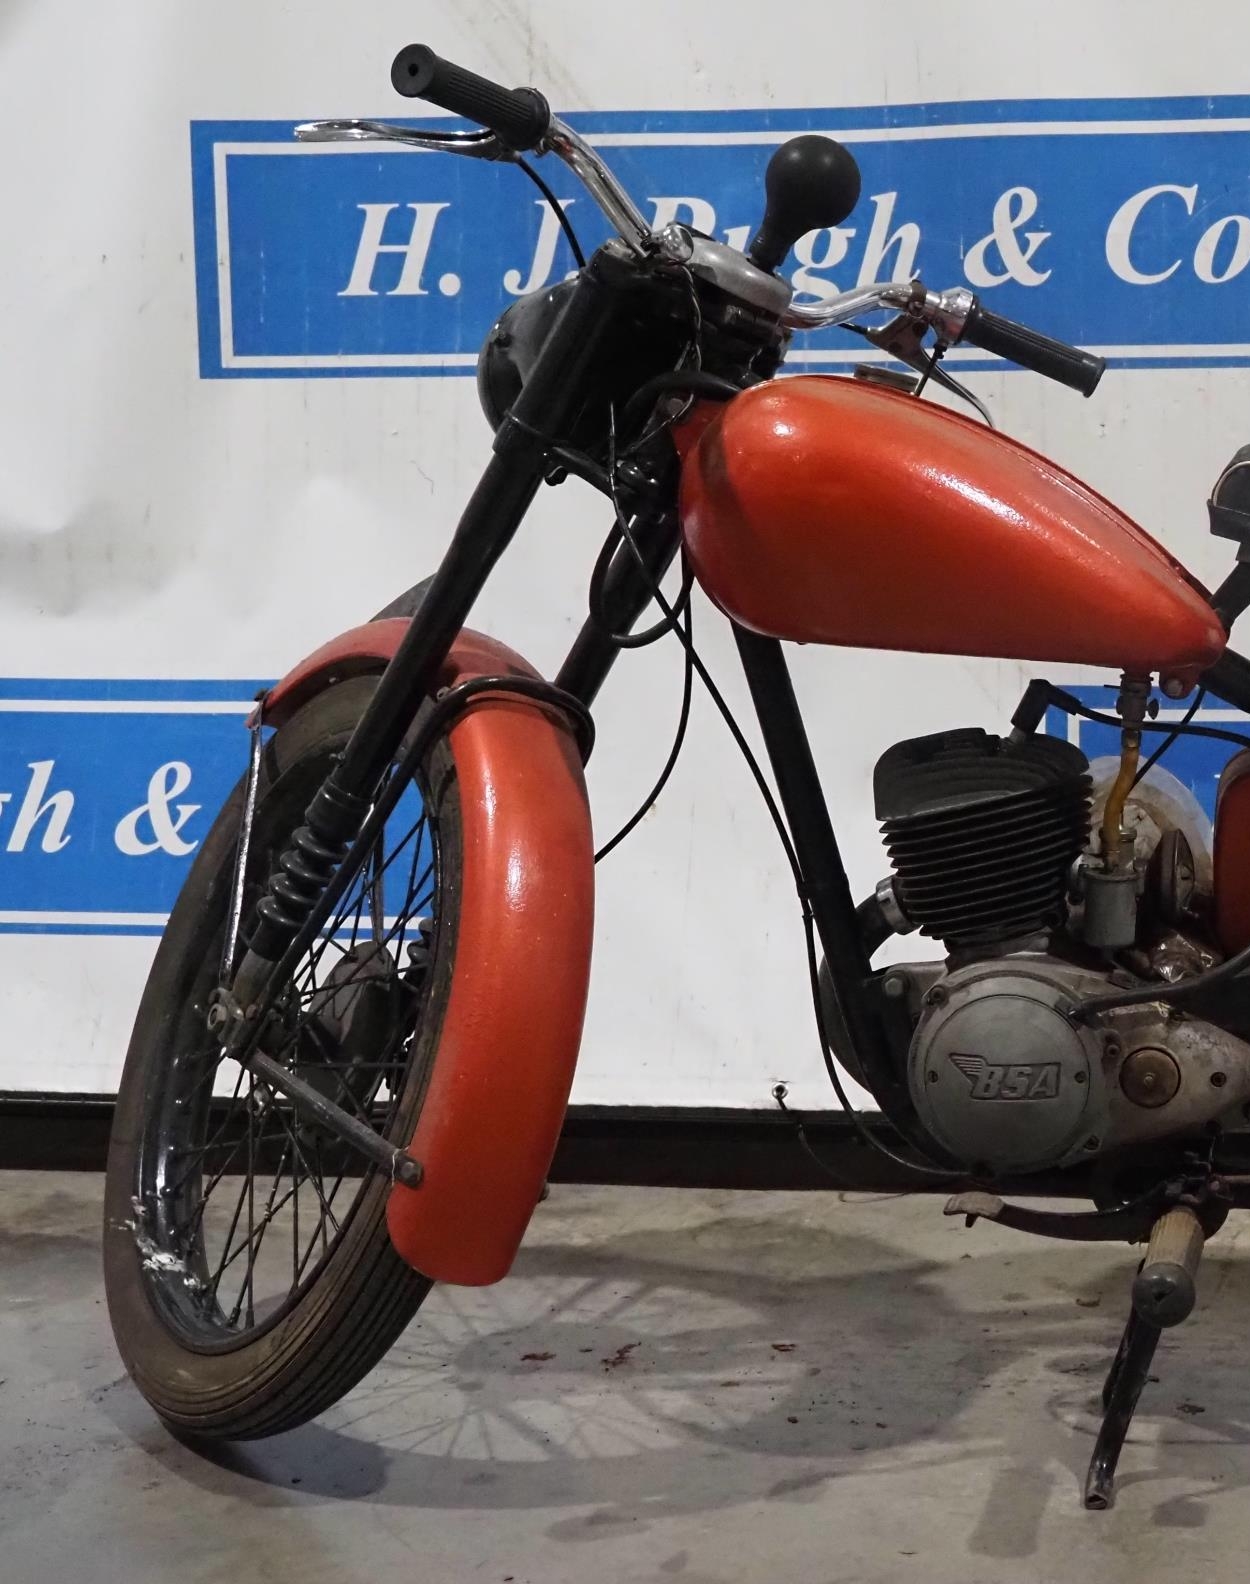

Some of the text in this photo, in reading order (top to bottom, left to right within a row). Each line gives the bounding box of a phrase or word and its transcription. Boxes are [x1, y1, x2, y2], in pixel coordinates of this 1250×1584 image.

[338, 202, 462, 297] H.
[645, 191, 922, 302] Pgh
[963, 186, 1052, 287] &
[0, 760, 202, 856] h &
[970, 1064, 1061, 1100] BSA
